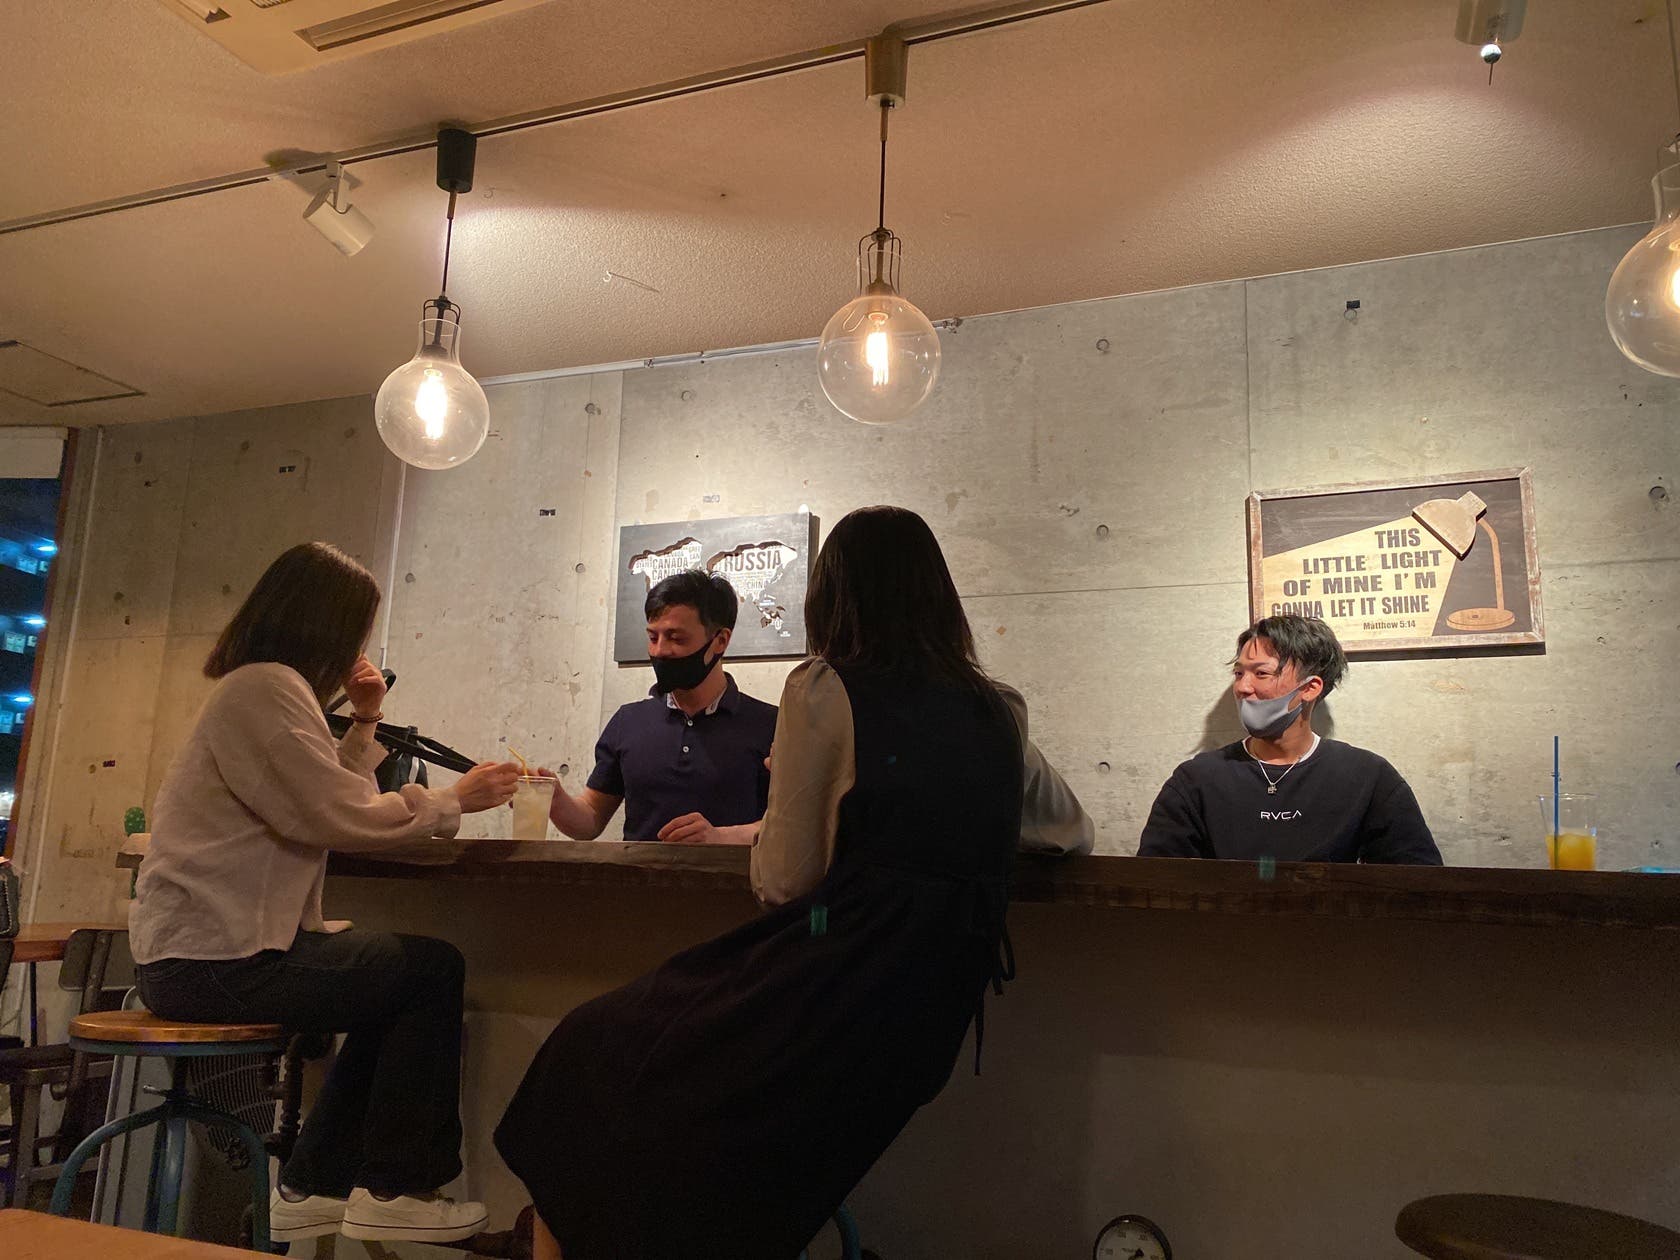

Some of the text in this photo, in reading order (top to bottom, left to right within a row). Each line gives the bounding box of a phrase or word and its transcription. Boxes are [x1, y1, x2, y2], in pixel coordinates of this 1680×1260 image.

[1374, 528, 1421, 549] THIS
[652, 557, 689, 569] CANADA
[724, 550, 782, 572] RUSSIA
[1303, 550, 1442, 575] LITTLE LIGHT
[1283, 571, 1437, 597] OF MINE I'M
[1271, 594, 1430, 619] GONNA LET IT SHINE
[1363, 619, 1416, 631] Matthew 5:14
[1260, 810, 1302, 820] RVCA
